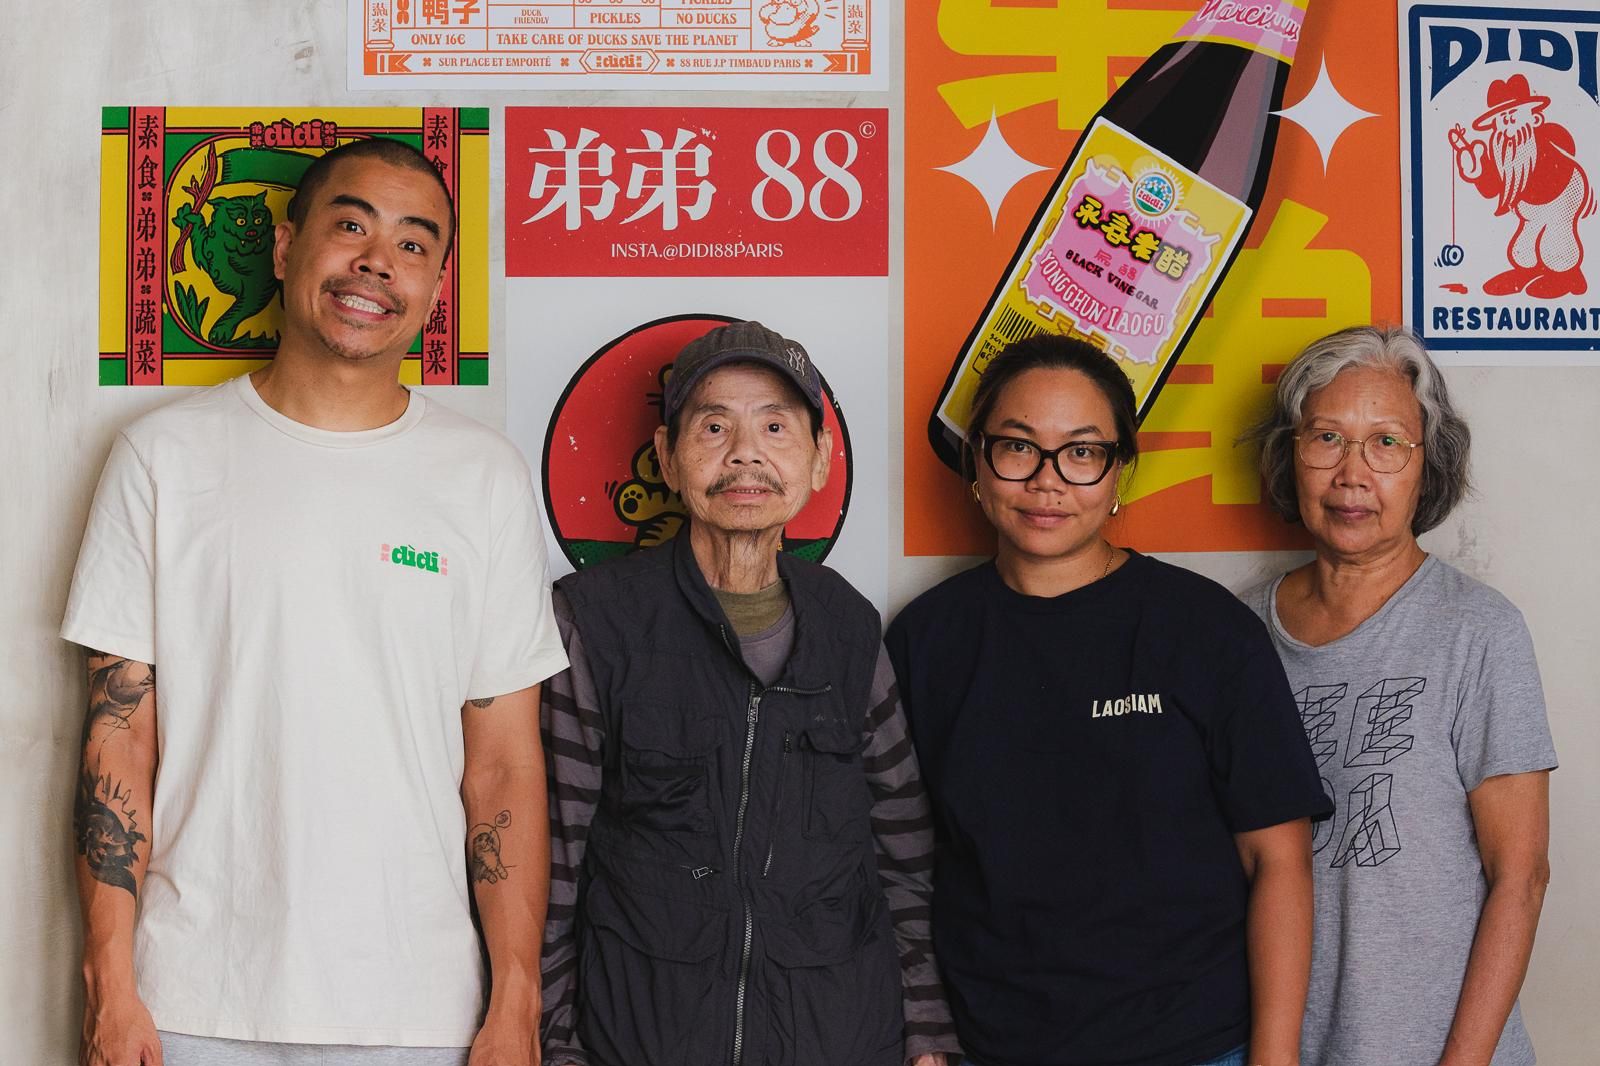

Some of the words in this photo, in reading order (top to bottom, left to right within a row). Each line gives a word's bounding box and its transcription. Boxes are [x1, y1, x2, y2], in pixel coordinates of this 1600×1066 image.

[514, 16, 550, 24] FRIENDLY
[590, 12, 641, 24] PICKLES
[676, 13, 693, 24] NO
[696, 13, 737, 24] DUCKS
[411, 34, 442, 45] ONLY
[496, 34, 528, 45] TAKE
[531, 34, 565, 45] CARE
[568, 34, 584, 45] OF
[588, 34, 628, 45] DUCKS
[632, 34, 661, 45] SAVE
[665, 34, 690, 45] THE
[693, 34, 738, 45] PLANET
[439, 57, 458, 67] SUR
[460, 57, 492, 67] PLACE
[493, 57, 506, 67] ET
[680, 58, 691, 68] 88
[693, 58, 712, 68] RUE
[729, 58, 771, 68] TIMBAUD
[773, 58, 801, 68] PARIS
[1428, 25, 1600, 106] DIDI
[137, 114, 159, 189] 素食
[522, 128, 717, 231] 弟弟
[751, 129, 862, 221] 88
[135, 207, 158, 281] 弟弟
[1075, 195, 1192, 279] 永春老醋
[611, 243, 784, 260] INSTA.@DIDI88PARIS
[1065, 249, 1104, 278] BLACK
[1107, 272, 1159, 310] VINEGAR
[1432, 305, 1600, 331] RESTAURANT
[134, 299, 157, 376] 蔬菜
[1092, 693, 1163, 718] LAOSIAM
